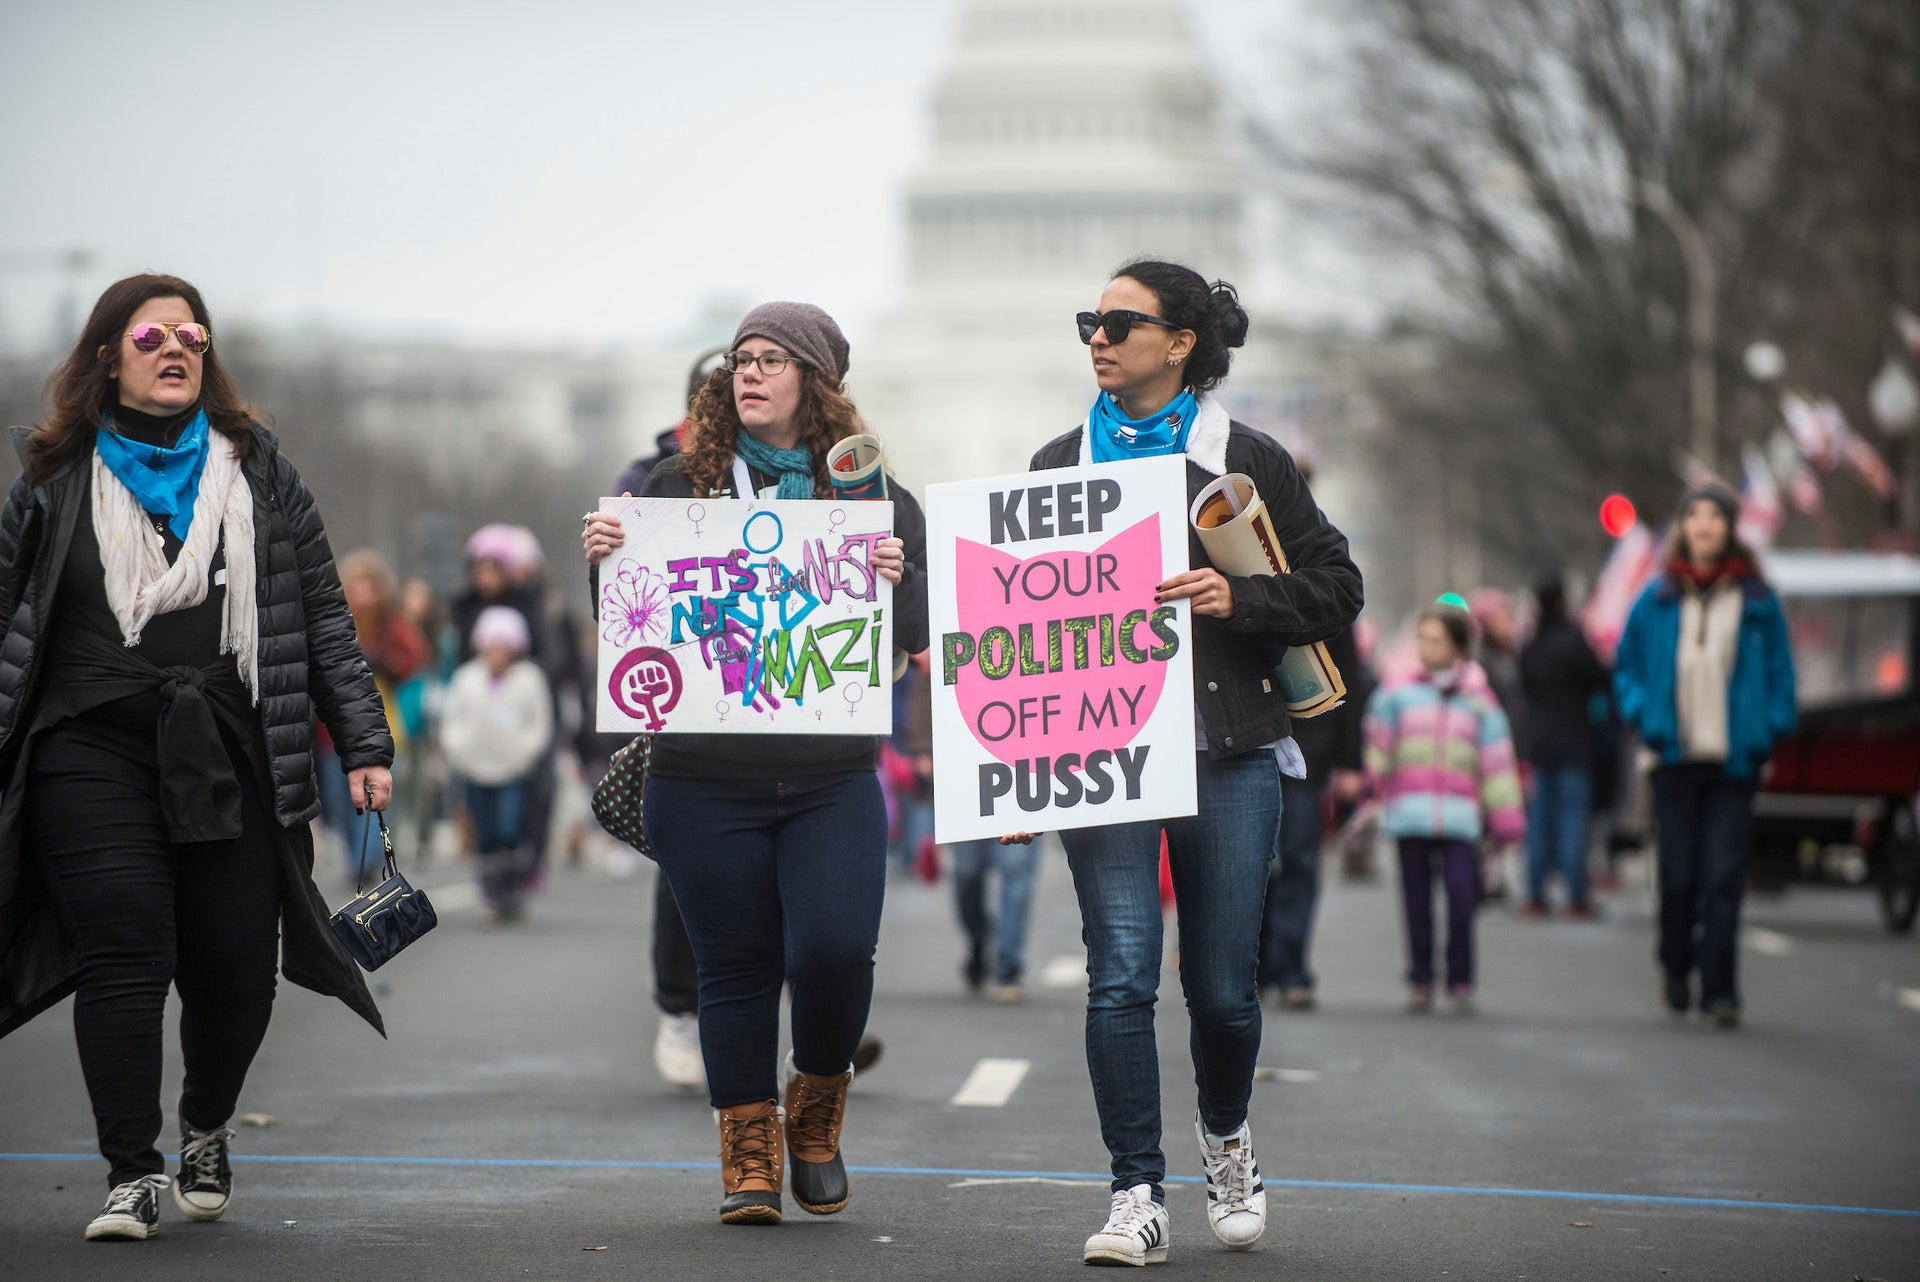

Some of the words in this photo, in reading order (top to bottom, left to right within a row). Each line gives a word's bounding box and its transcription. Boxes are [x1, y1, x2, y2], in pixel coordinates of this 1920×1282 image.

[989, 479, 1121, 544] KEEP
[993, 553, 1120, 604] YOUR
[670, 594, 740, 644] NOT
[943, 606, 1179, 685] POLITICS
[977, 695, 1061, 742] OFF
[1078, 685, 1146, 731] MY
[979, 745, 1150, 816] PUSSY
